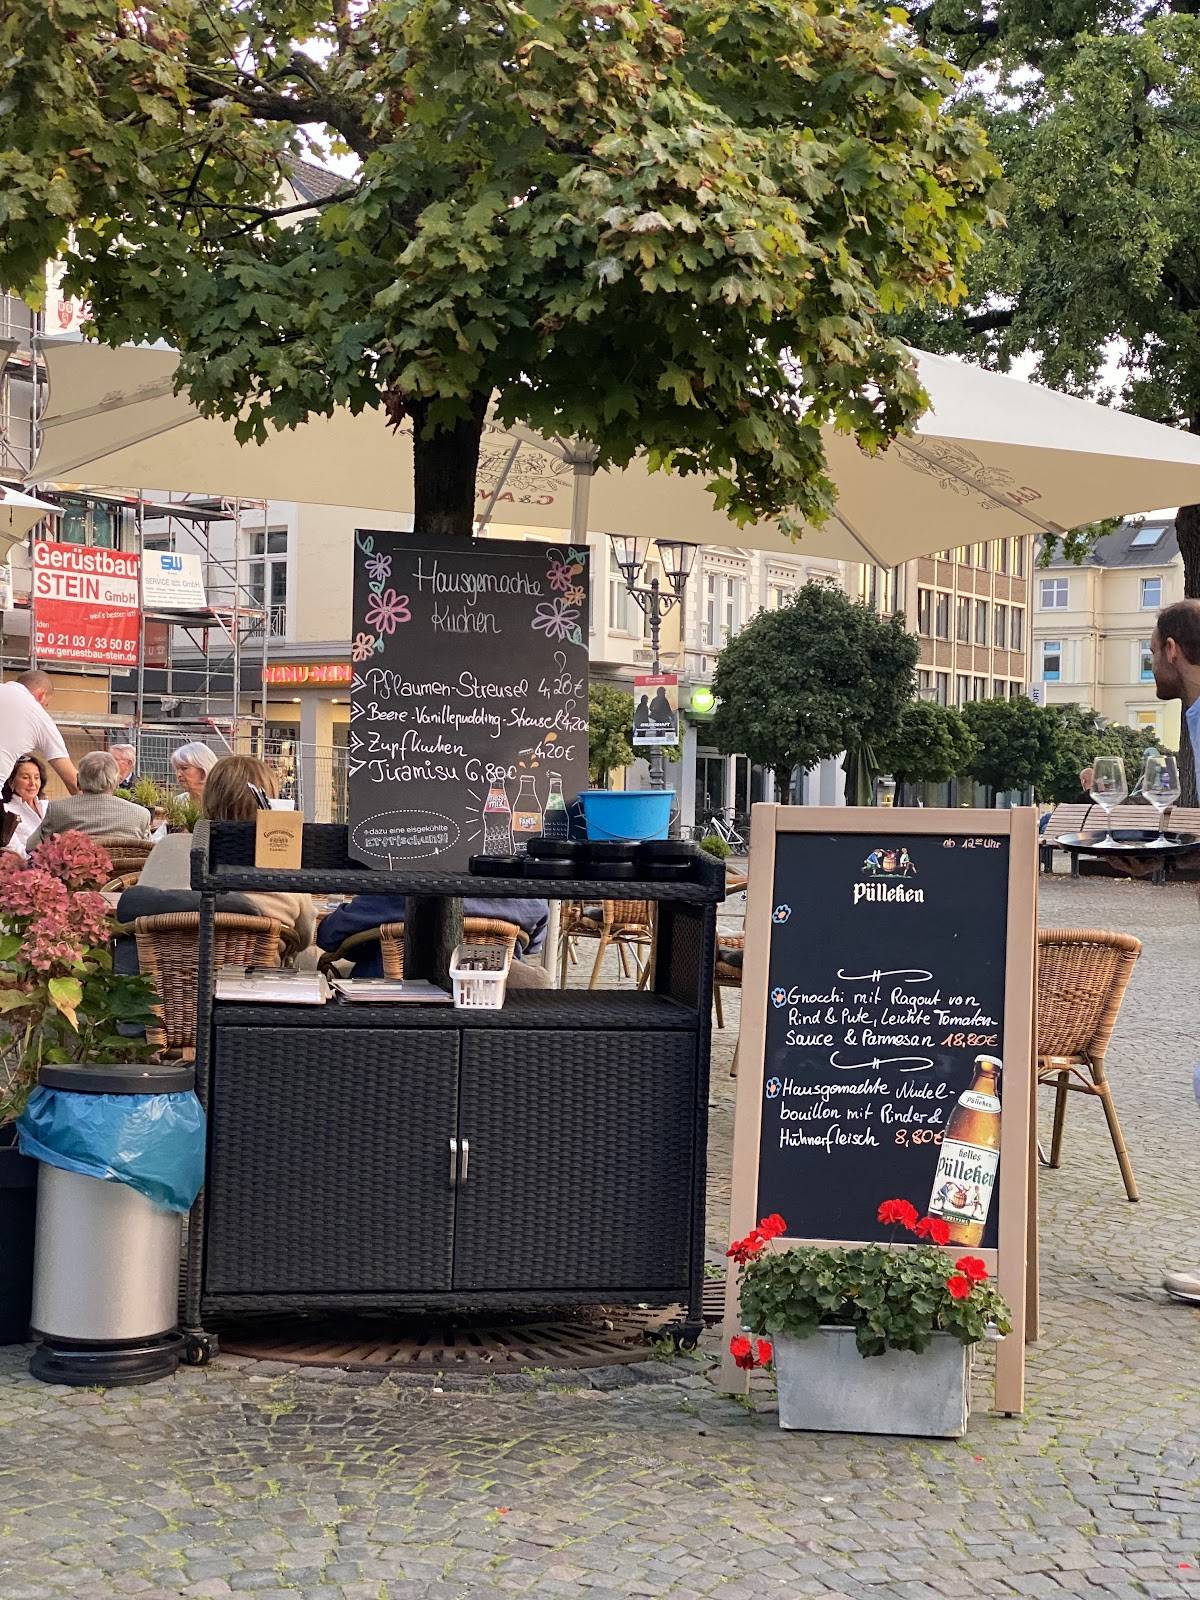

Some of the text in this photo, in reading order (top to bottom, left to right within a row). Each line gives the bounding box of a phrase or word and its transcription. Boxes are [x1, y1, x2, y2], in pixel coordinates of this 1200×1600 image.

[34, 543, 137, 577] Gerüstbau
[37, 572, 99, 600] STEIN
[104, 591, 136, 604] GmbH
[412, 557, 544, 605] Hausgemachte
[431, 602, 502, 633] Kuchen
[48, 633, 136, 651] 0 21 03 / 33 50 87
[366, 668, 528, 699] Pflaumen-Streusel
[368, 758, 517, 783] Tiramisu 6,80€
[943, 838, 956, 848] ab
[983, 838, 1001, 848] Uhr
[854, 882, 925, 904] Pülleken
[787, 986, 981, 1015] Gnocchi mit Ragout von
[788, 1007, 820, 1026] Rind
[824, 1007, 838, 1024] &
[841, 1007, 877, 1027] Pute,
[933, 1008, 998, 1027] Tomaten-
[785, 1028, 998, 1048] Sauce & Parmesan 18,80€
[782, 1077, 890, 1102] Hausgemachte
[780, 1101, 943, 1124] bouillon mit Rinder &
[780, 1123, 880, 1153] Hühnerfleisch
[958, 1149, 982, 1162] helles
[937, 1156, 994, 1188] Pülleken
